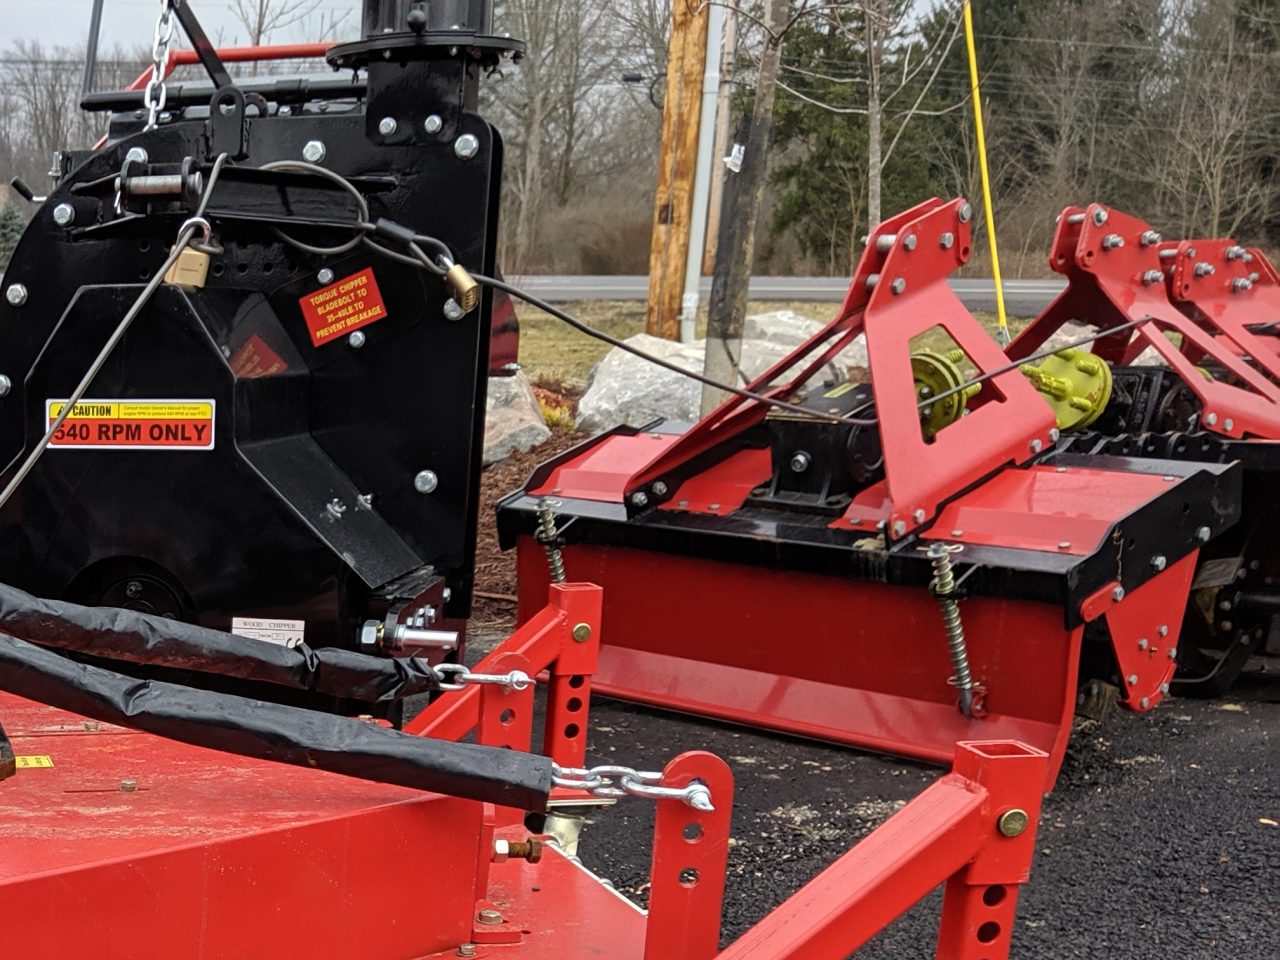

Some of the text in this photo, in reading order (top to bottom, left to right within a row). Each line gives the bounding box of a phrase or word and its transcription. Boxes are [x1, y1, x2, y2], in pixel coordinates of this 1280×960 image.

[310, 275, 368, 306] TORQUE CHIPPER
[317, 288, 367, 315] BLADEBOLT TO
[316, 305, 382, 339] PREVENT BREAKAGE
[72, 405, 111, 416] CAUTION
[54, 423, 207, 441] 540 RPM ONLY
